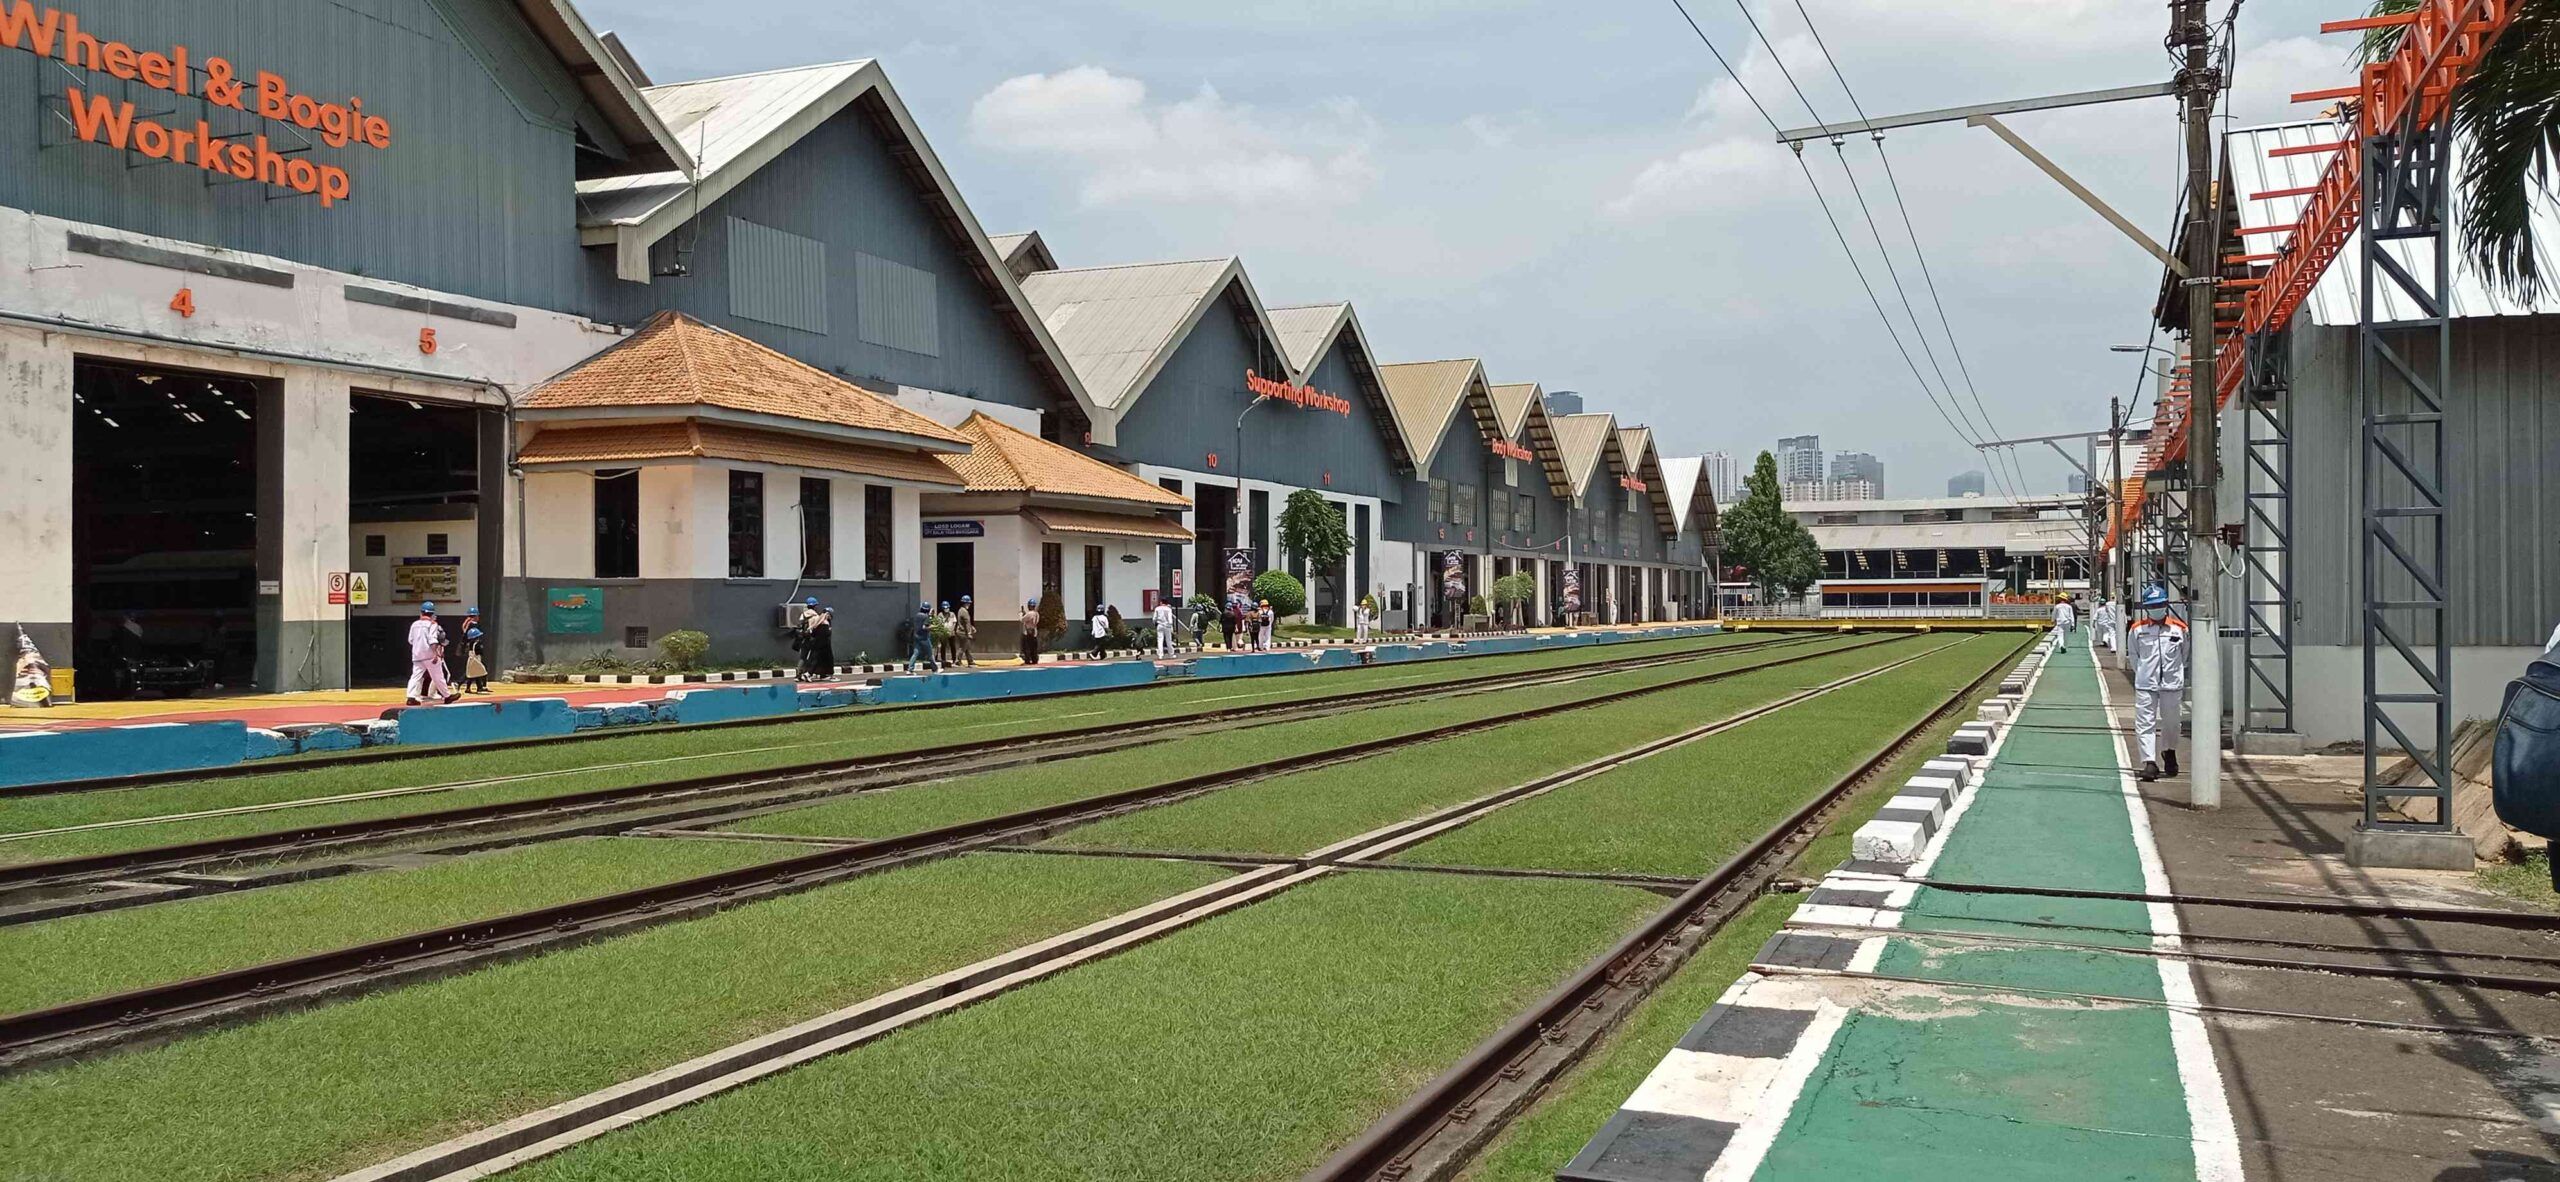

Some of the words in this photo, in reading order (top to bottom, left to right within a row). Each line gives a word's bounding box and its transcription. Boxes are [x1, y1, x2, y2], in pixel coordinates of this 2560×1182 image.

[0, 0, 188, 96] Wheel
[205, 56, 244, 110] &
[257, 69, 391, 149] Bogie
[67, 87, 349, 208] Workshop
[170, 288, 195, 318] 4
[418, 328, 437, 354] 5
[1246, 368, 1304, 408] Supporting
[1304, 385, 1351, 418] Workshop
[1207, 453, 1217, 468] 10
[1492, 438, 1507, 458] Body
[1506, 440, 1533, 464] Workshop
[1322, 472, 1330, 486] 11
[334, 577, 340, 587] 5
